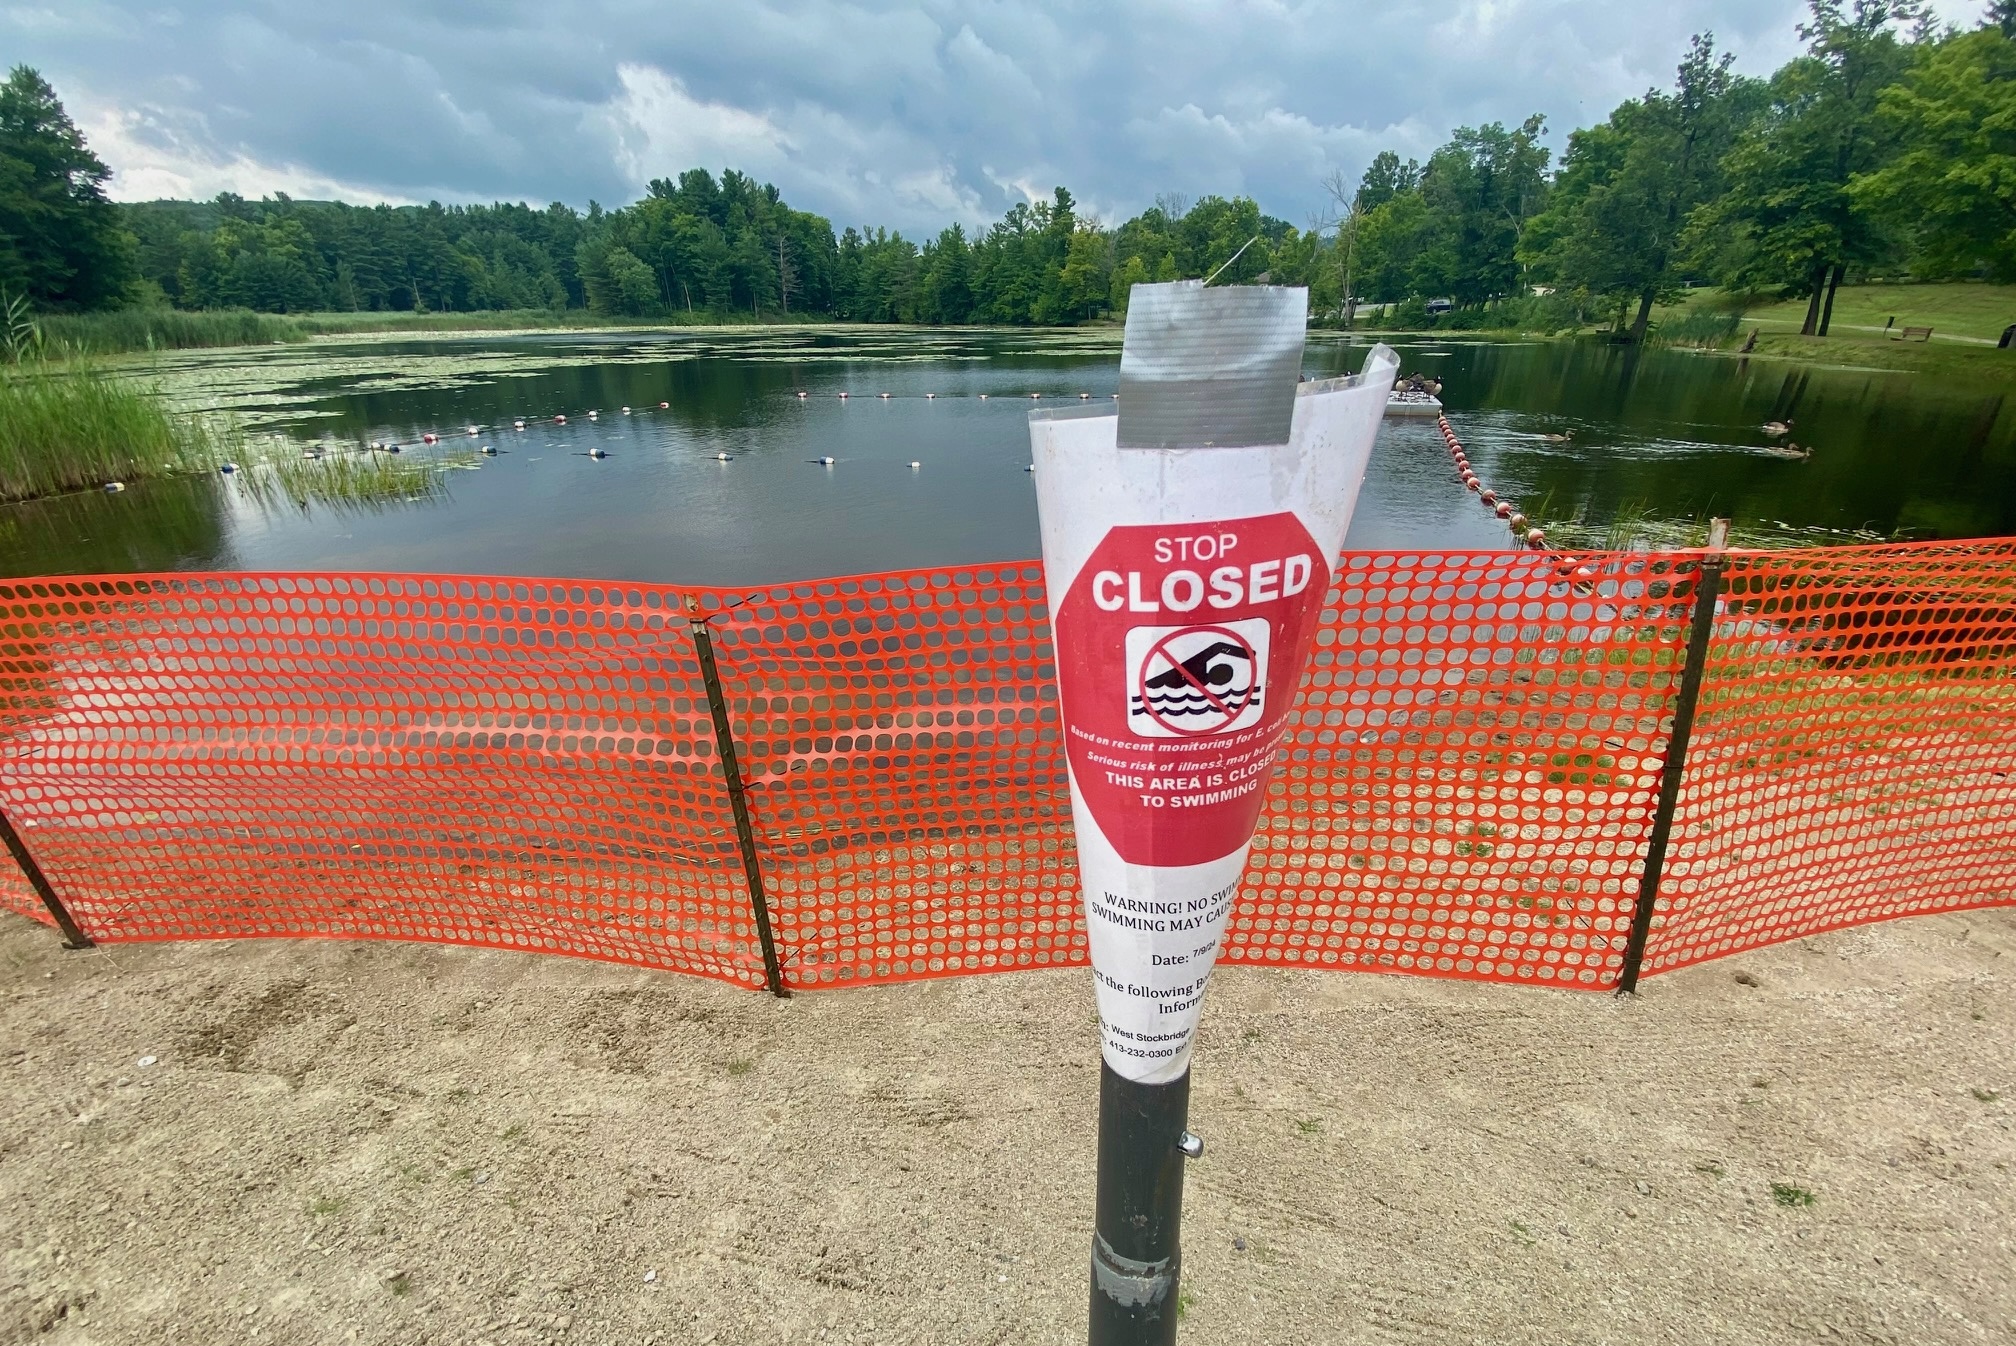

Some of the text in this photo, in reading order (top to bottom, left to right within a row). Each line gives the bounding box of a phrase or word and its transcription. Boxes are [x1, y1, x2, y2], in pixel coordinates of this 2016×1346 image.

[1154, 533, 1237, 563] STOP
[1092, 553, 1312, 612] CLOSED
[1070, 724, 1095, 742] Based
[1096, 736, 1109, 746] on
[1112, 740, 1154, 752] recent
[1158, 738, 1233, 752] monitoring
[1236, 733, 1254, 745] for
[1255, 727, 1264, 738] E.
[1087, 751, 1127, 769] Serious
[1130, 761, 1157, 772] risk
[1159, 762, 1174, 772] of
[1226, 752, 1252, 767] may
[1253, 746, 1264, 758] be
[1105, 749, 1276, 790] THIS AREA IS CLOSED
[1140, 779, 1258, 808] TO SWIMMING
[1092, 902, 1165, 931] SWIMMING
[1170, 916, 1203, 931] MAY
[1104, 891, 1182, 914] WARNING!
[1187, 898, 1208, 912] NO
[1152, 938, 1216, 966] Date: 7/9/24
[1105, 976, 1124, 992] the
[1128, 984, 1193, 998] following
[1111, 1024, 1134, 1040] West
[1136, 1027, 1190, 1042] Stockbridge
[1109, 1040, 1173, 1058] 413-232-0300
